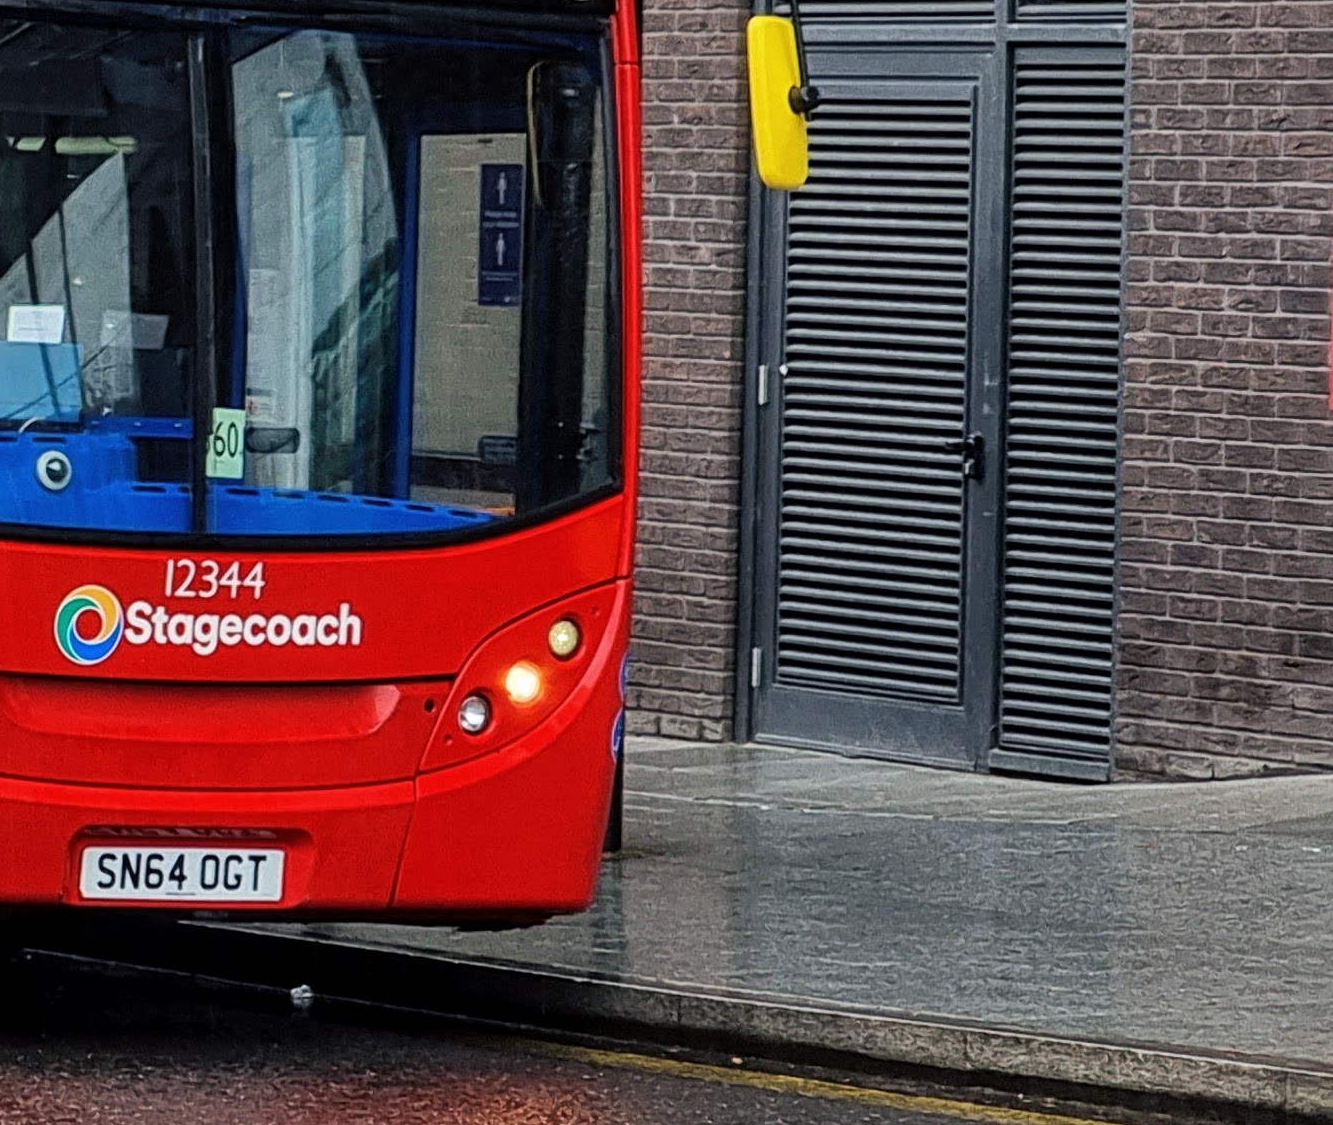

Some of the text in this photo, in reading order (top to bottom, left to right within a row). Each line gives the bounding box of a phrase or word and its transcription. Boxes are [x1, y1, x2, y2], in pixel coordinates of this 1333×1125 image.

[165, 559, 266, 599] 12344
[124, 600, 362, 656] Stagecoach
[96, 852, 268, 892] SN64 OGT
